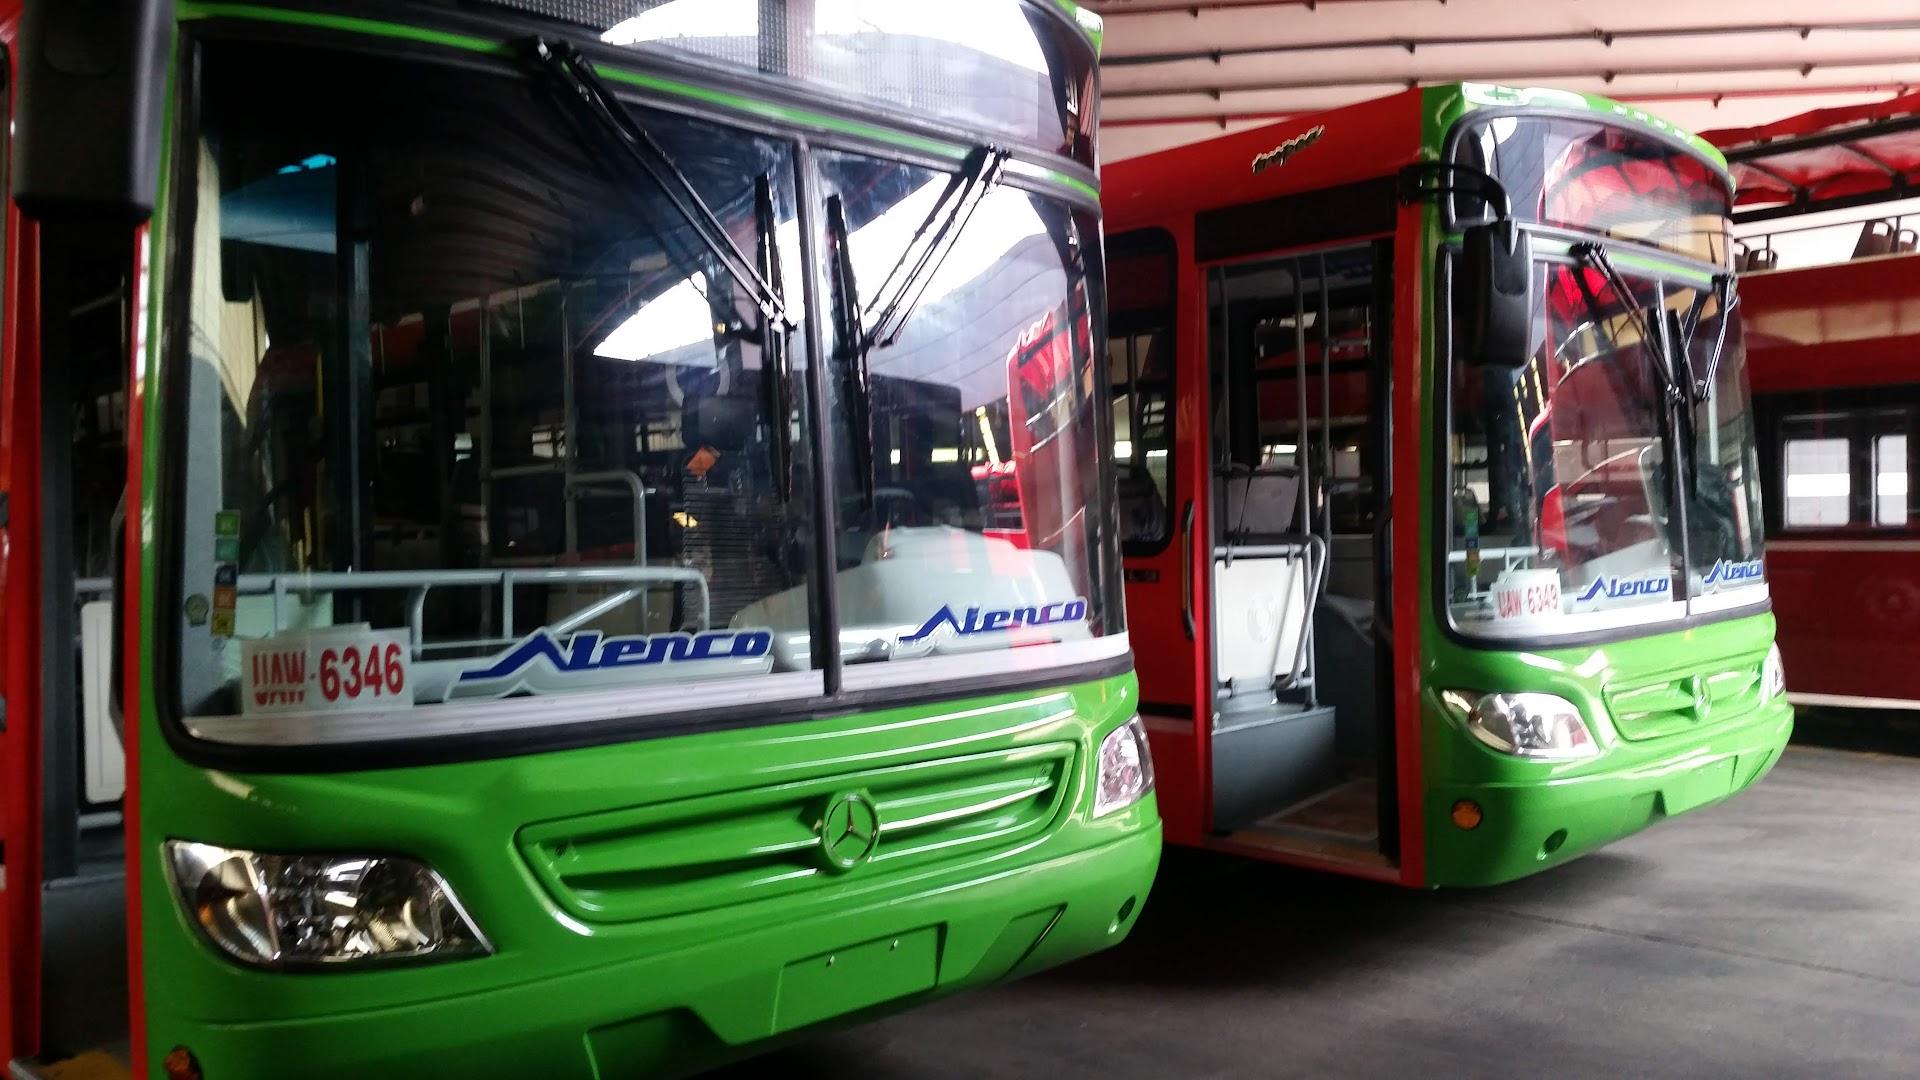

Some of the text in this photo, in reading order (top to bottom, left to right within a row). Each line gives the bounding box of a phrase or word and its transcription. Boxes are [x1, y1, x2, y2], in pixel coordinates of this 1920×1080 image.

[1577, 575, 1669, 602] Alenco
[898, 600, 1086, 642] Alenco
[459, 630, 772, 681] Alenco
